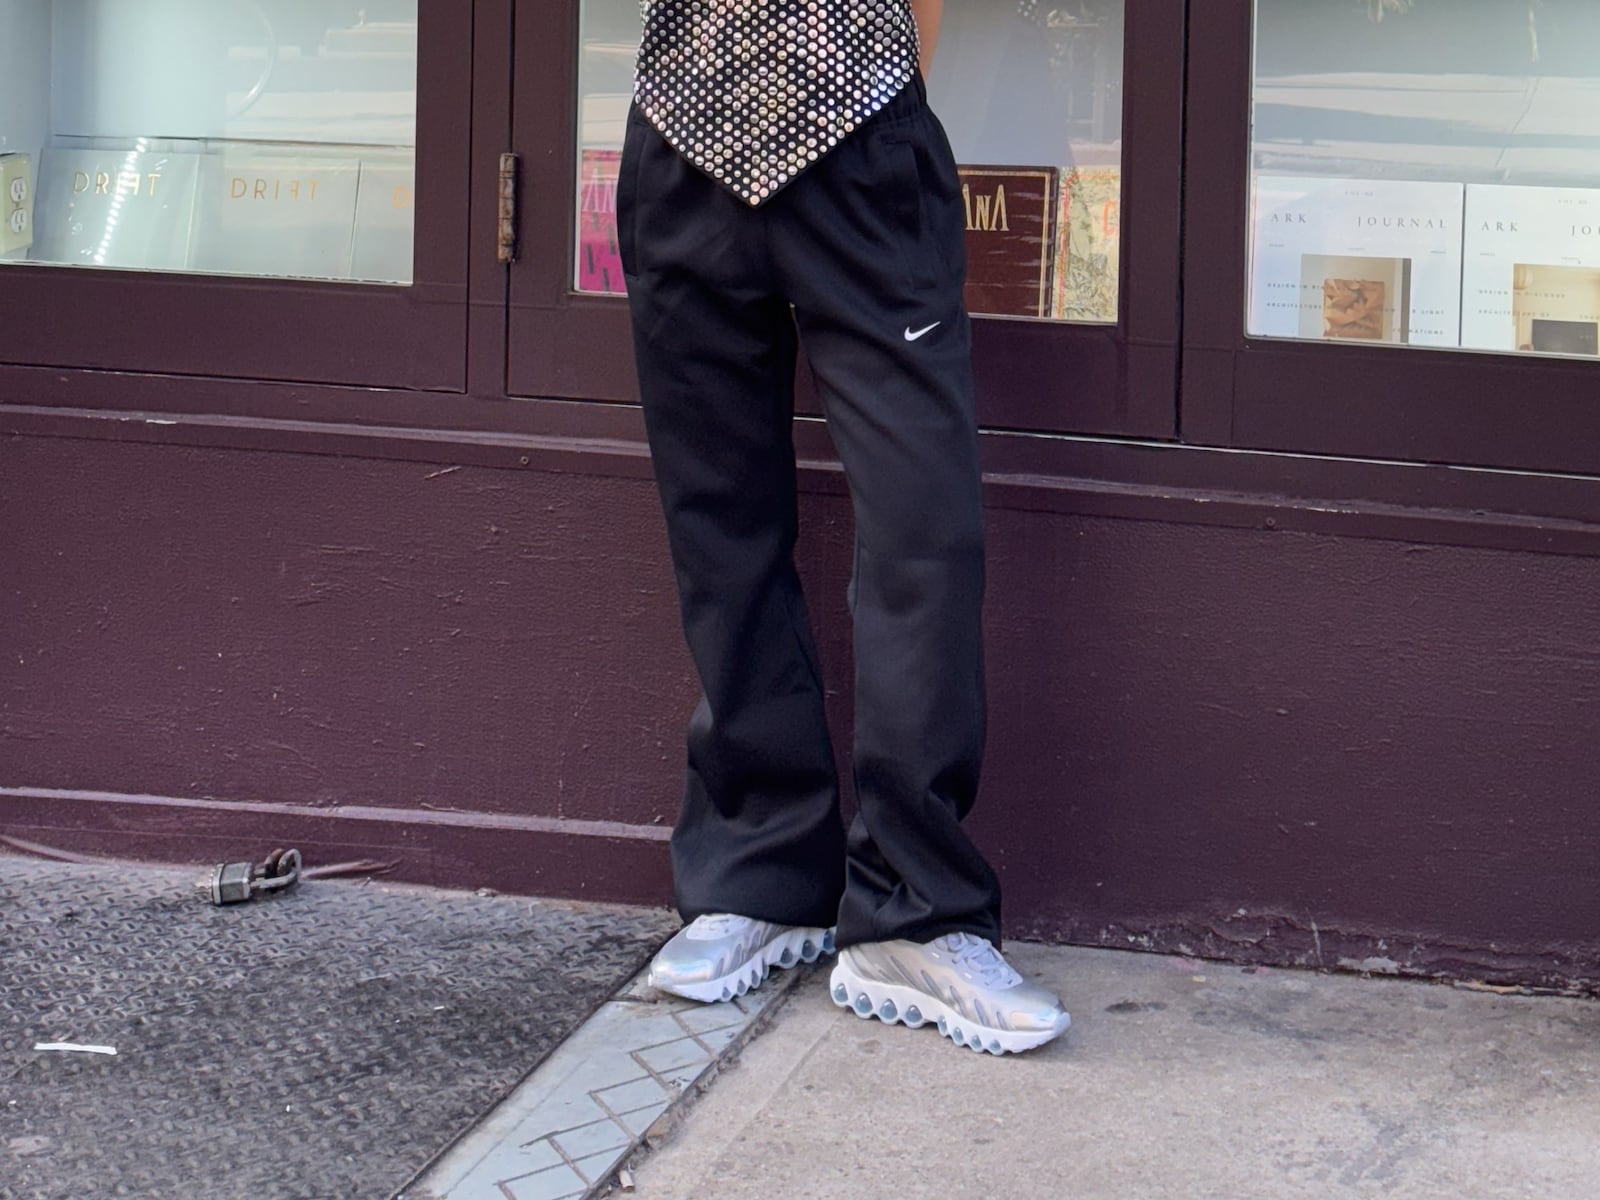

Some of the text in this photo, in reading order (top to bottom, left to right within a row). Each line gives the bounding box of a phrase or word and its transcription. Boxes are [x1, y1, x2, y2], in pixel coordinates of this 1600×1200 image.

[1270, 212, 1446, 229] ARK JOURNAL
[1481, 221, 1600, 237] ARK JO
